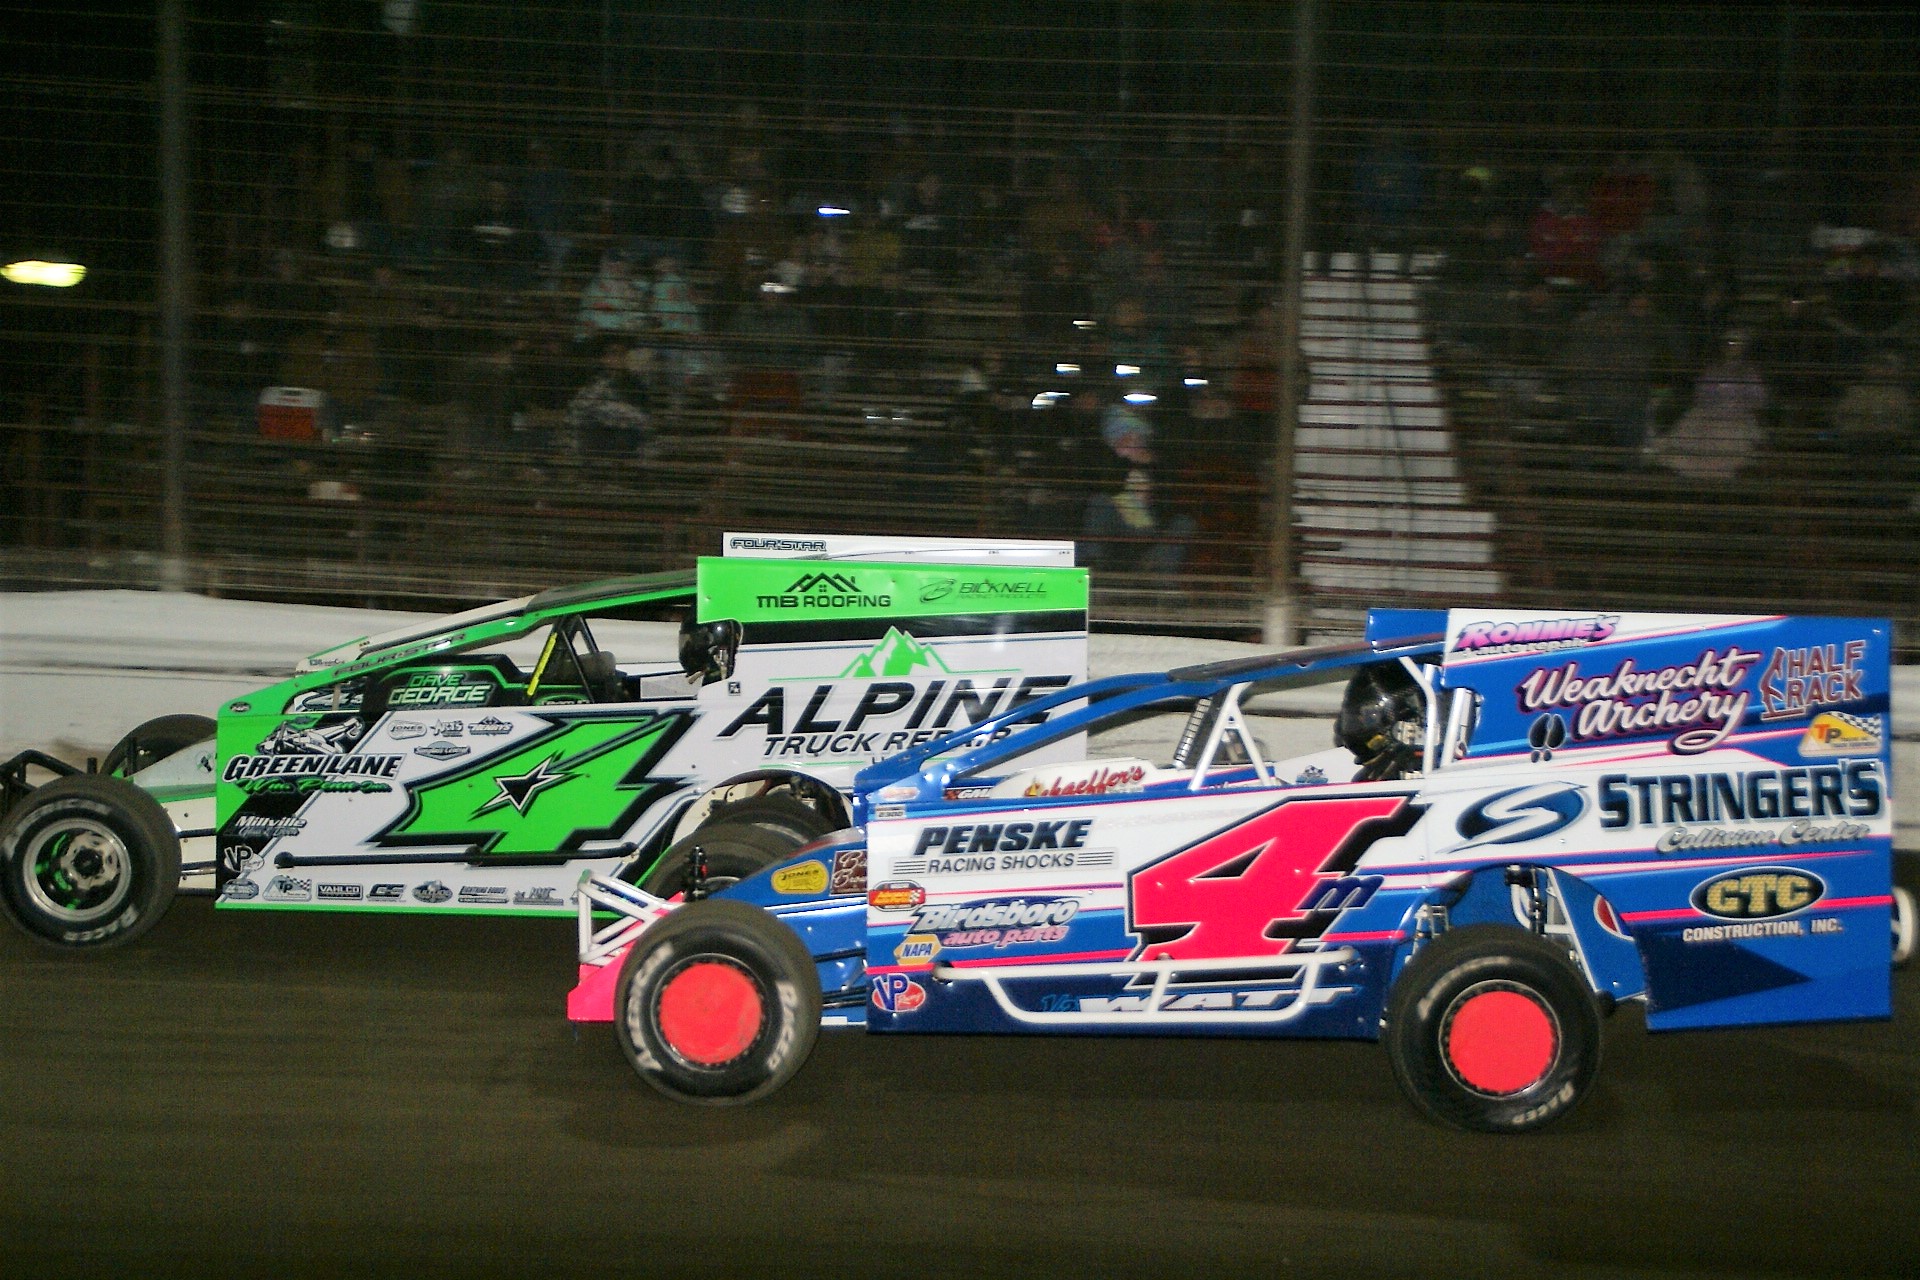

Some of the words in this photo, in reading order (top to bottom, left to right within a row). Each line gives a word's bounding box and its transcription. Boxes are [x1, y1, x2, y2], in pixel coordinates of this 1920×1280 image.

[959, 582, 1048, 594] BICKNELL
[757, 595, 798, 608] MB
[803, 594, 891, 608] ROOFING
[1451, 615, 1621, 652] RONNIE'S
[1787, 640, 1866, 678] HALF
[409, 674, 464, 687] DAVE
[1518, 647, 1761, 711] Weaknecht
[1786, 669, 1863, 708] RACK
[387, 685, 492, 705] GEORGE
[716, 675, 1073, 737] ALPINE
[763, 733, 880, 756] TRUCK
[1814, 723, 1842, 744] TP
[1598, 760, 1884, 830] STRINGER'S
[235, 816, 307, 829] Millville
[913, 819, 1093, 856] PENSKE
[225, 847, 253, 873] VP
[927, 856, 996, 874] RACING
[1001, 852, 1075, 870] SHOCKS
[782, 869, 820, 881] JONES
[320, 885, 360, 893] VAHLCO
[1706, 873, 1810, 913] CTC
[910, 899, 1079, 933] Birdsboro
[943, 929, 1000, 947] auto
[996, 926, 1069, 949] parts
[1683, 919, 1803, 943] CONSTRUCTION,
[1811, 918, 1843, 933] INC.
[902, 943, 932, 957] NAPA
[873, 973, 909, 1012] VP
